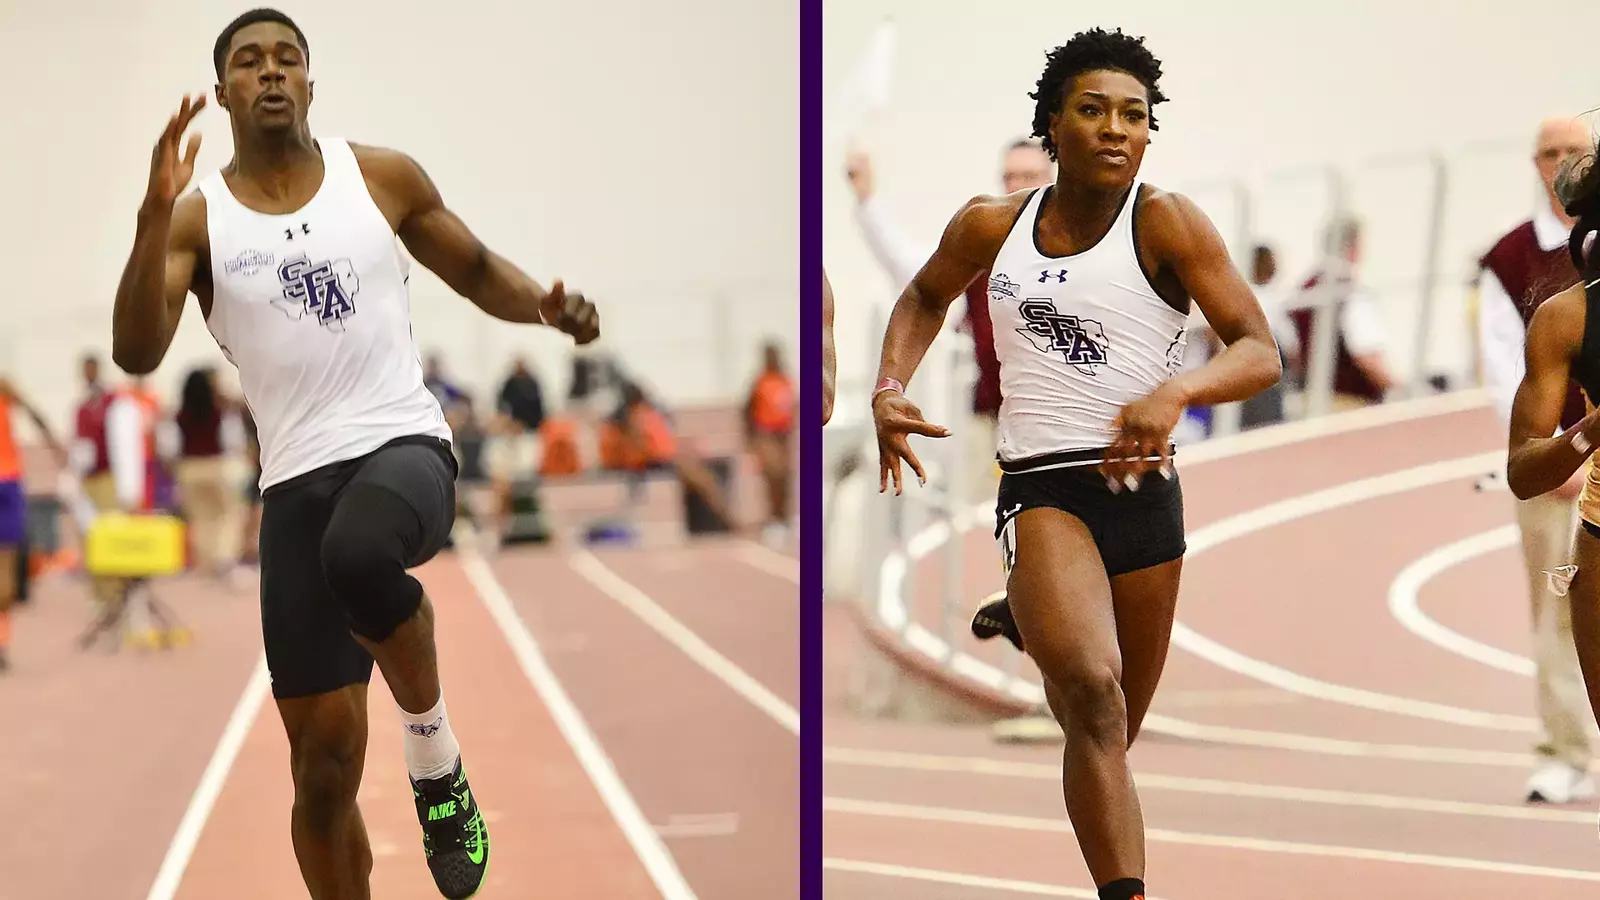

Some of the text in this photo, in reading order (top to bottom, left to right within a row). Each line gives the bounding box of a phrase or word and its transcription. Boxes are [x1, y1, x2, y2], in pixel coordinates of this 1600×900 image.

[277, 258, 356, 326] SFA
[1019, 301, 1108, 364] SFA
[428, 800, 457, 821] NIKE
